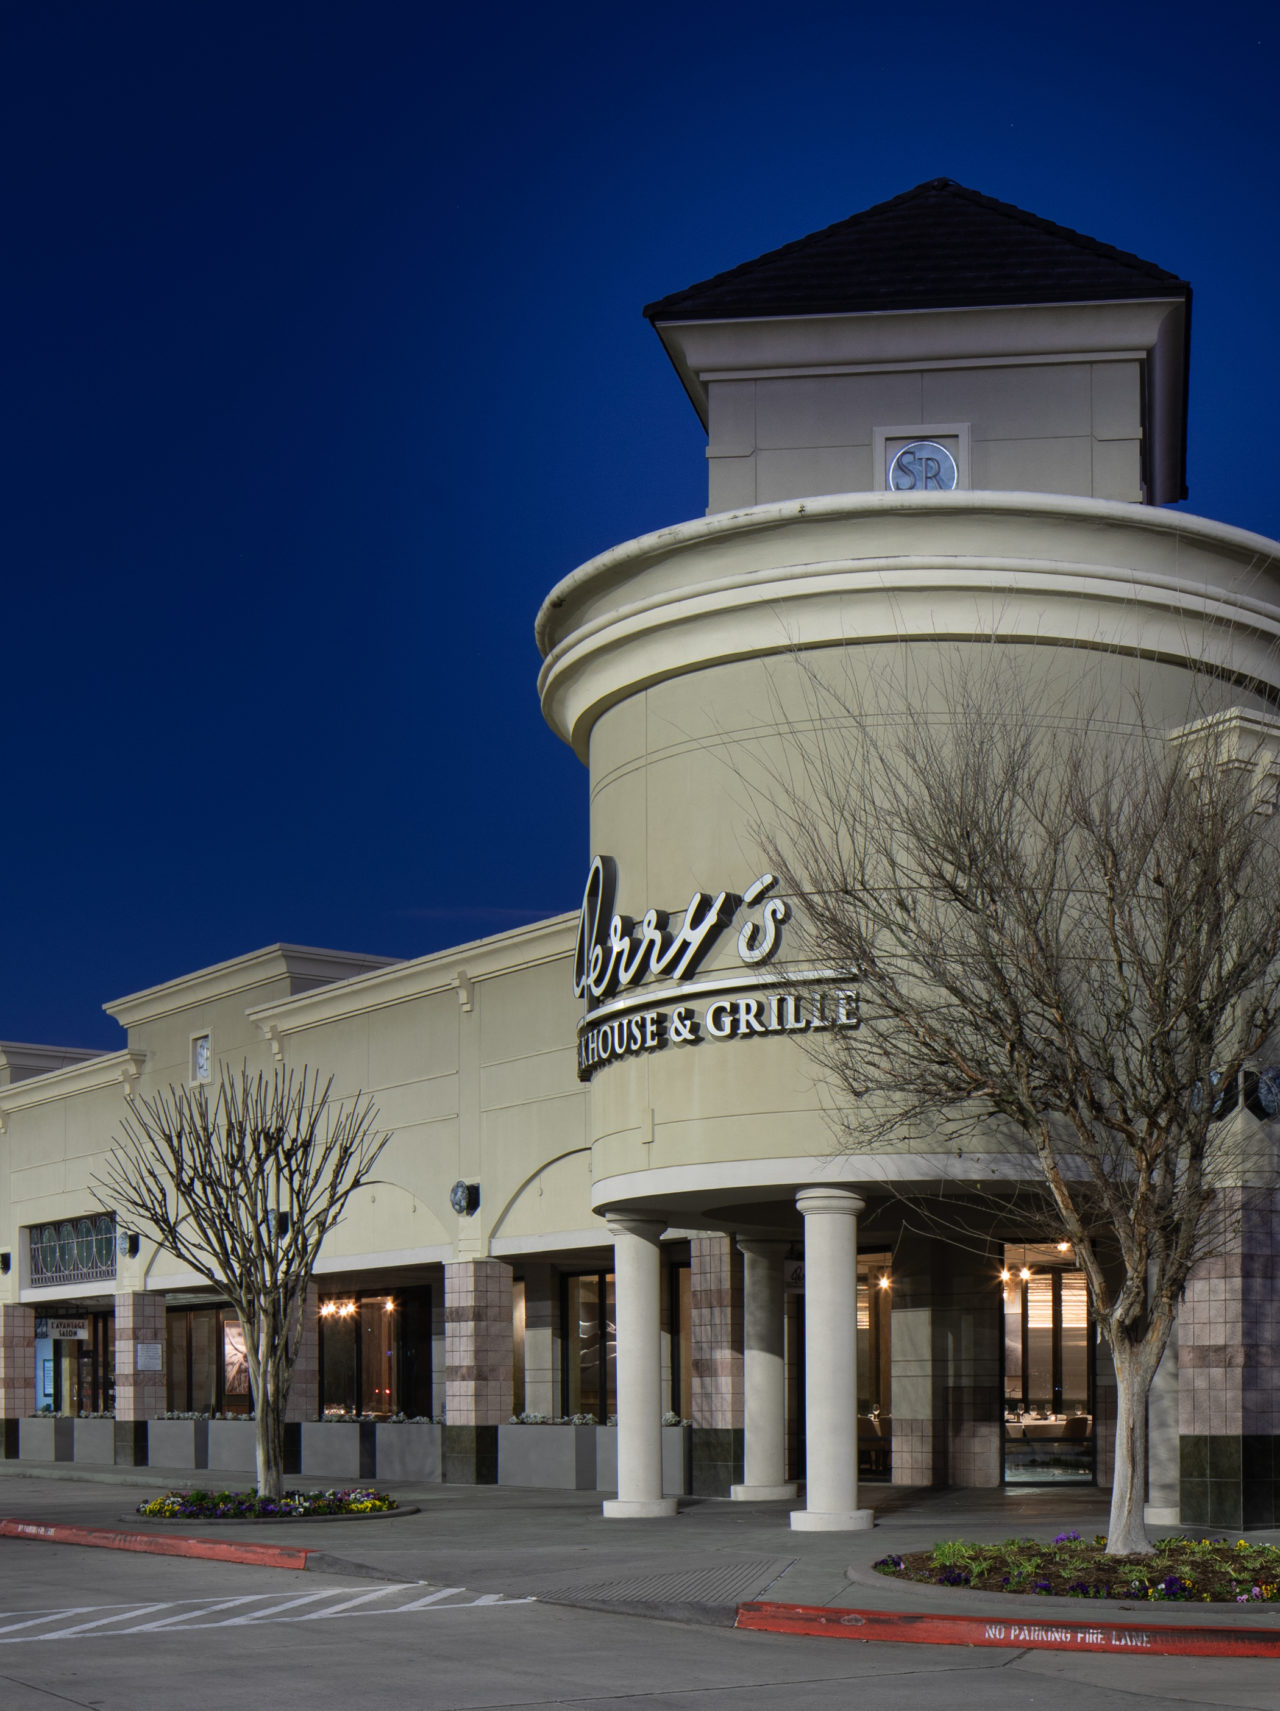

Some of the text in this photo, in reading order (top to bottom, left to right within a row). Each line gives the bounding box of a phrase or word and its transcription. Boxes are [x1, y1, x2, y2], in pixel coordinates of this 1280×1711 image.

[896, 451, 943, 490] SR
[578, 990, 859, 1069] KHOUSE & GRILLE
[985, 1624, 1152, 1647] NO PARKING FIRE LANE
